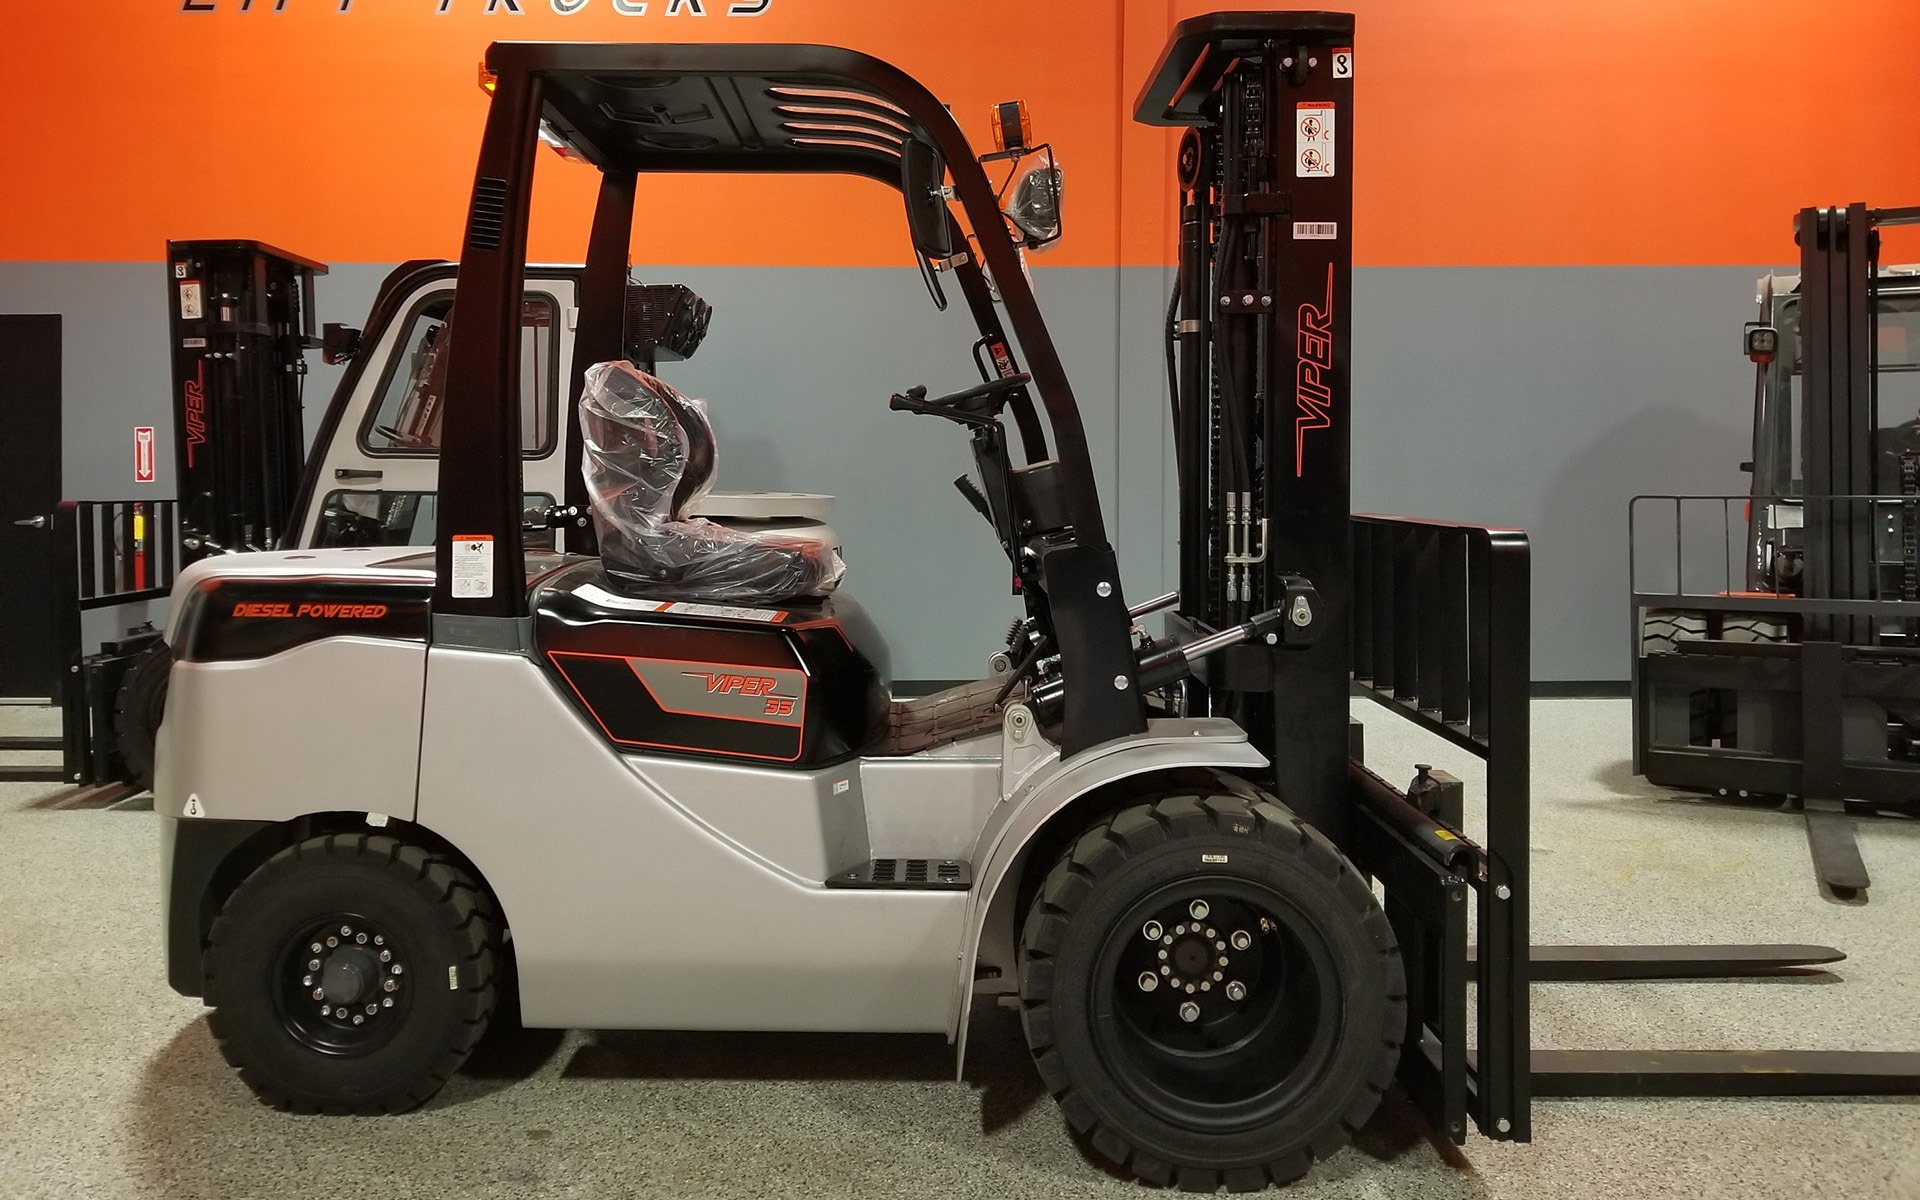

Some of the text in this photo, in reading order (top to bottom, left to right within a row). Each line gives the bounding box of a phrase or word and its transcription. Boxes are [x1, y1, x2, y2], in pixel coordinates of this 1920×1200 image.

[1296, 262, 1333, 478] VIPER
[185, 360, 206, 468] VIPER
[232, 603, 387, 618] DIESEL POWERED
[681, 671, 799, 700] VIPER
